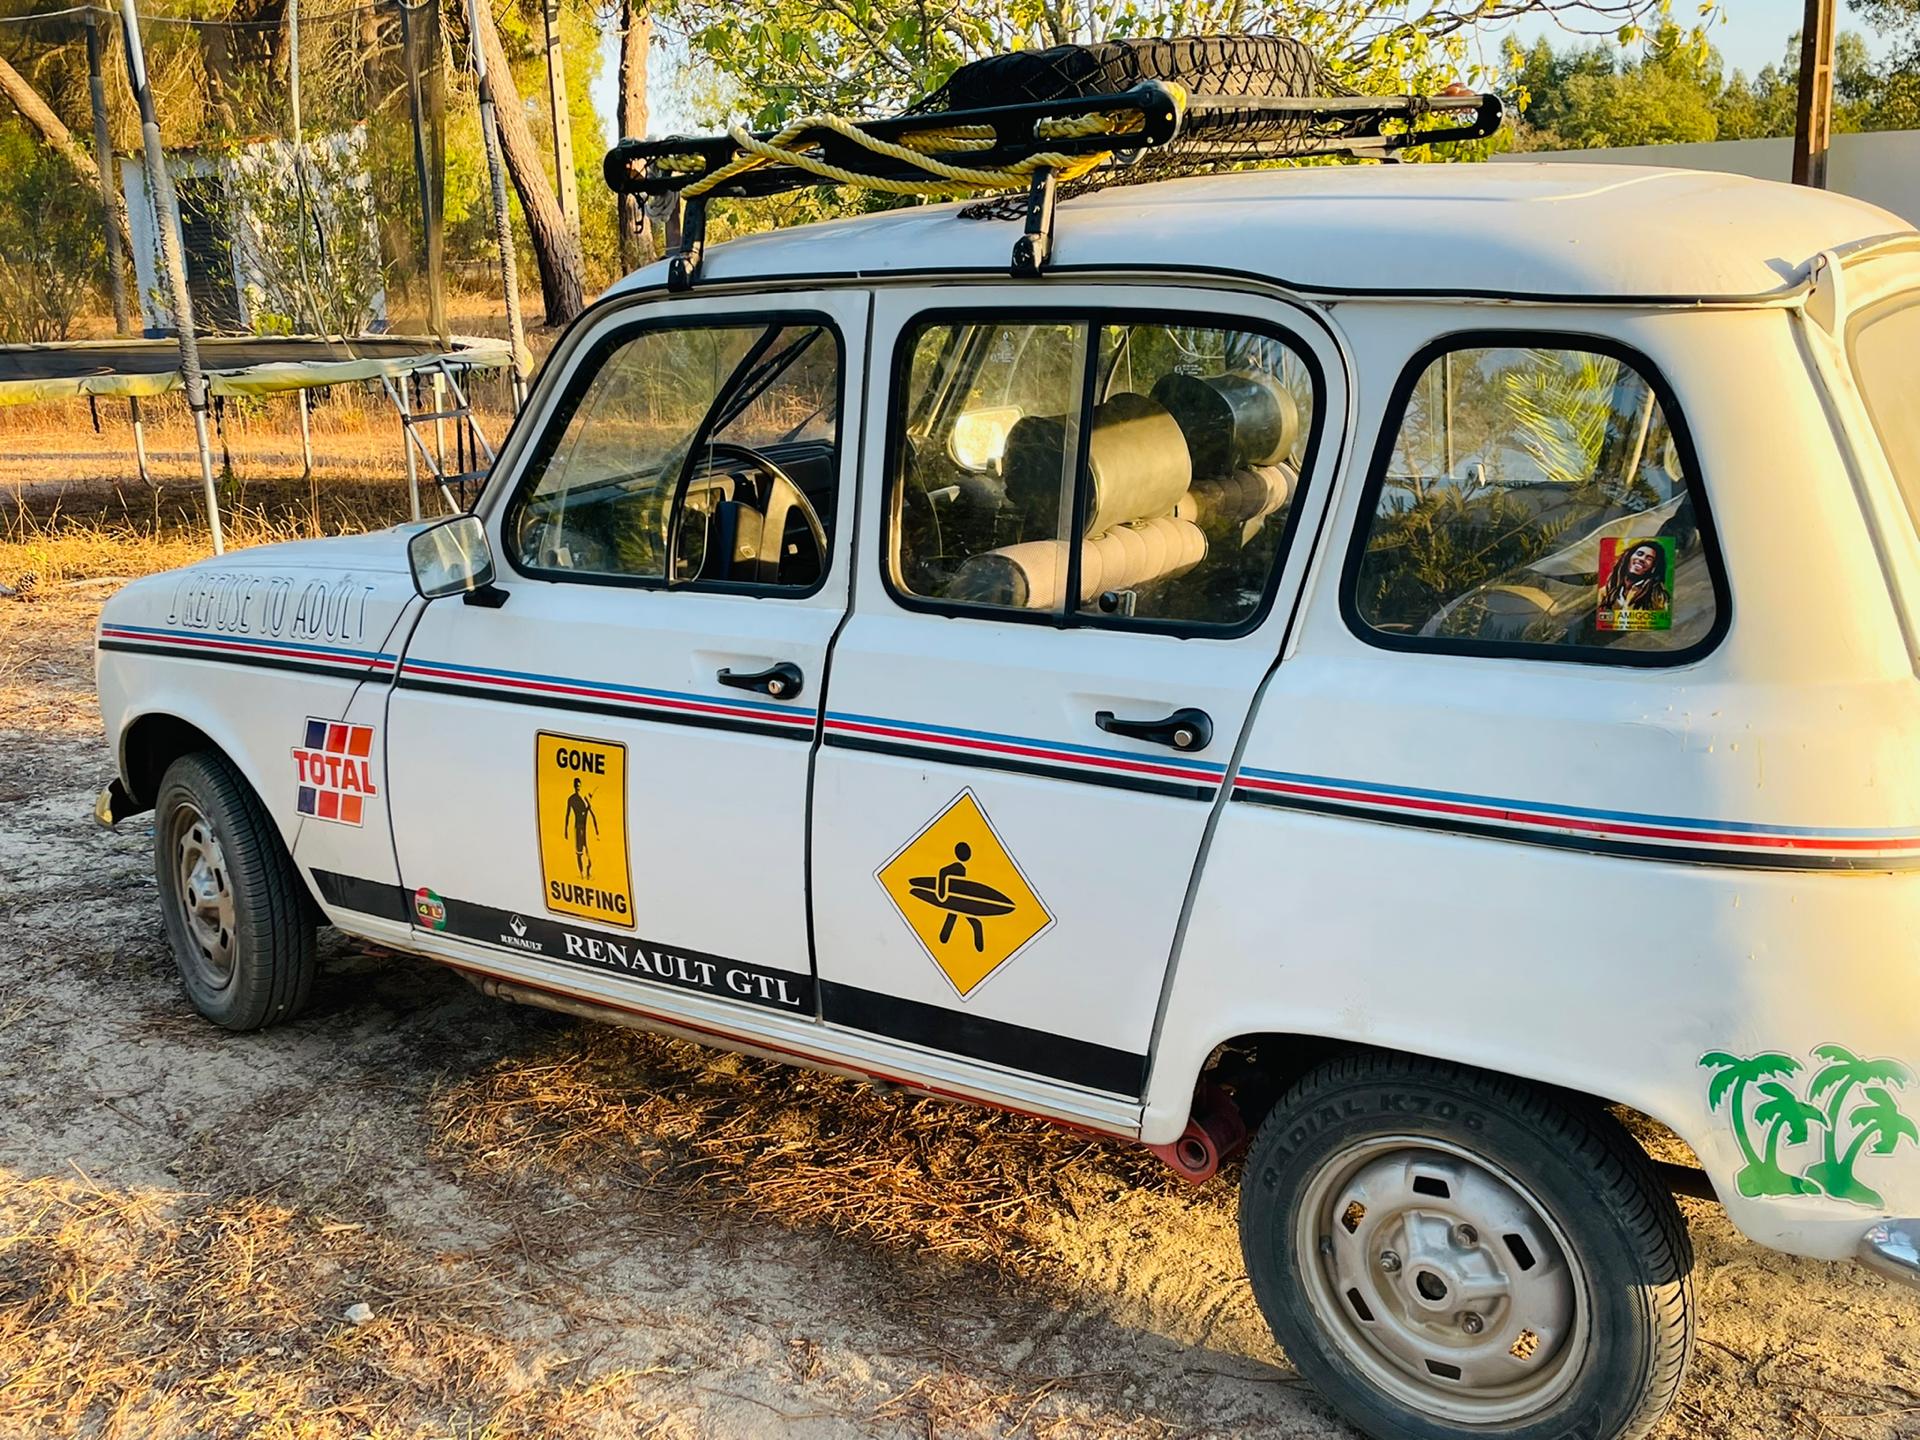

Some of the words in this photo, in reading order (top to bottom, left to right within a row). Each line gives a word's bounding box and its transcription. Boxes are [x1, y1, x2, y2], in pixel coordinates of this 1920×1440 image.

[183, 574, 261, 633] REFUSE
[261, 577, 294, 637] TO
[291, 578, 375, 642] ADULT
[1616, 611, 1658, 620] AMIGOS
[293, 750, 376, 794] TOTAL
[556, 748, 605, 775] GONE
[551, 881, 627, 913] SURFING
[500, 934, 543, 951] RENAULT
[563, 932, 716, 987] RENAULT
[726, 969, 800, 1006] GTL
[1264, 1100, 1366, 1192] RADIAL
